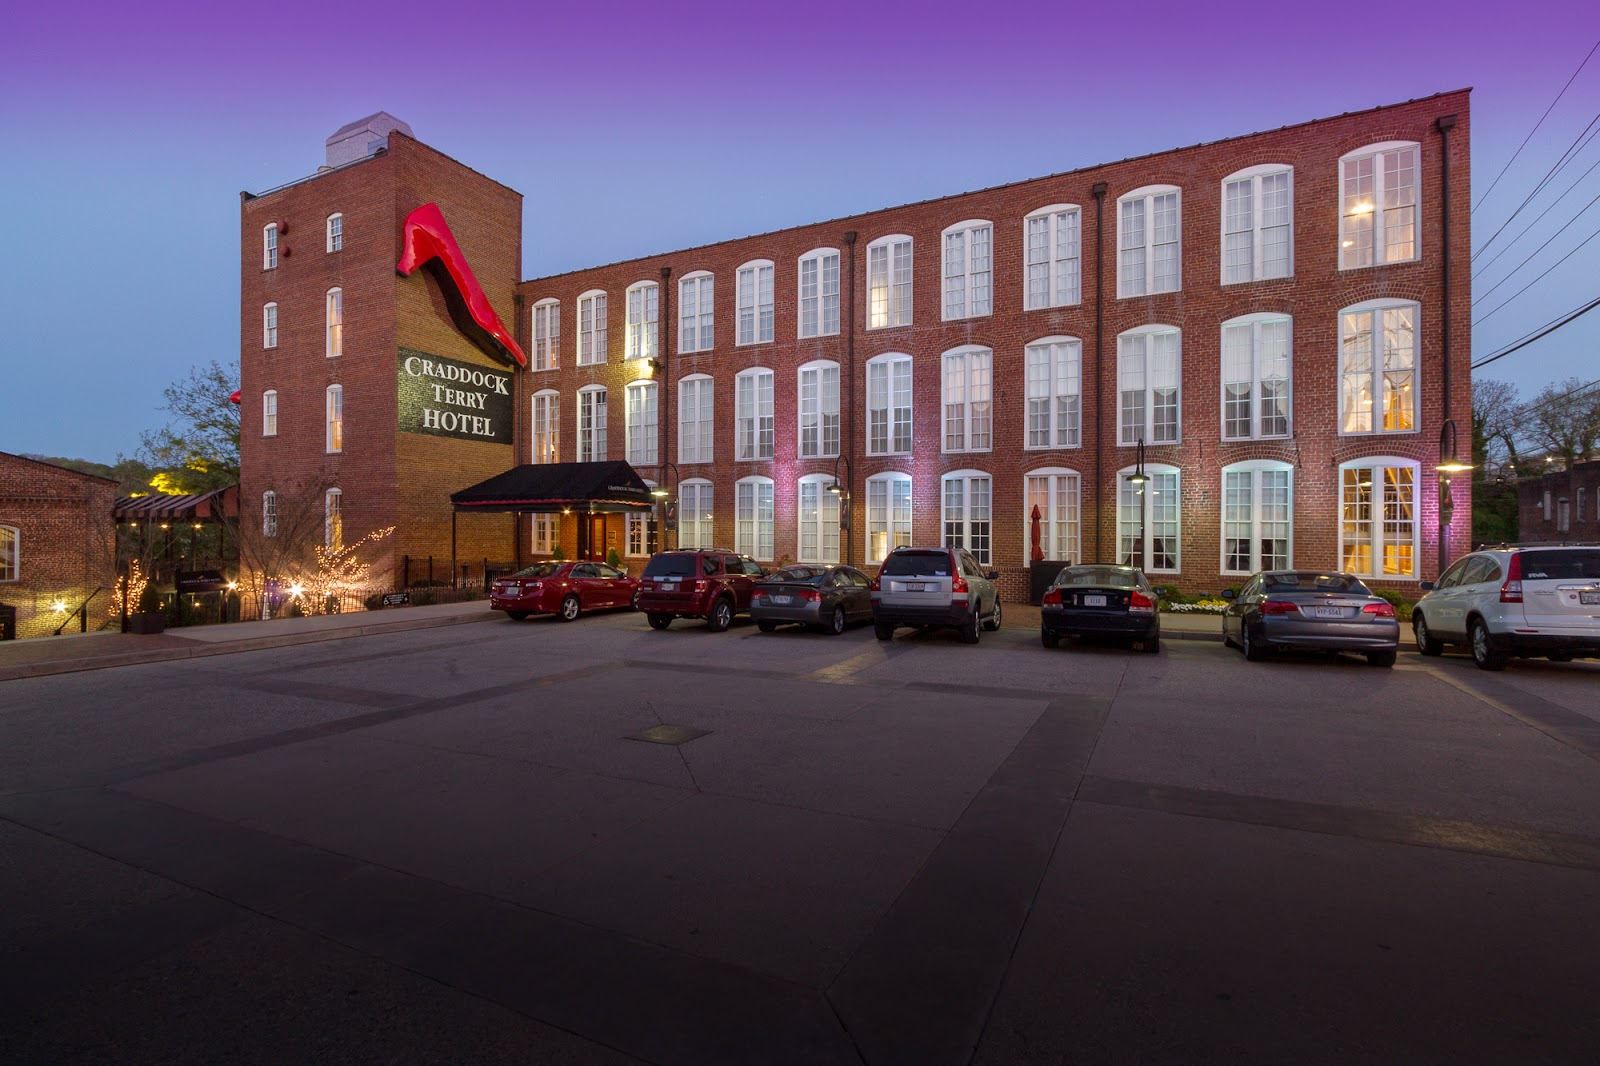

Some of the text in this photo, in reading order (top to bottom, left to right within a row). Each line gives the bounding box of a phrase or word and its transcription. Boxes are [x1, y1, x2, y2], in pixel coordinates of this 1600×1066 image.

[405, 357, 509, 395] CRADDOCK
[431, 384, 487, 409] TERRY
[423, 409, 495, 437] HOTEL
